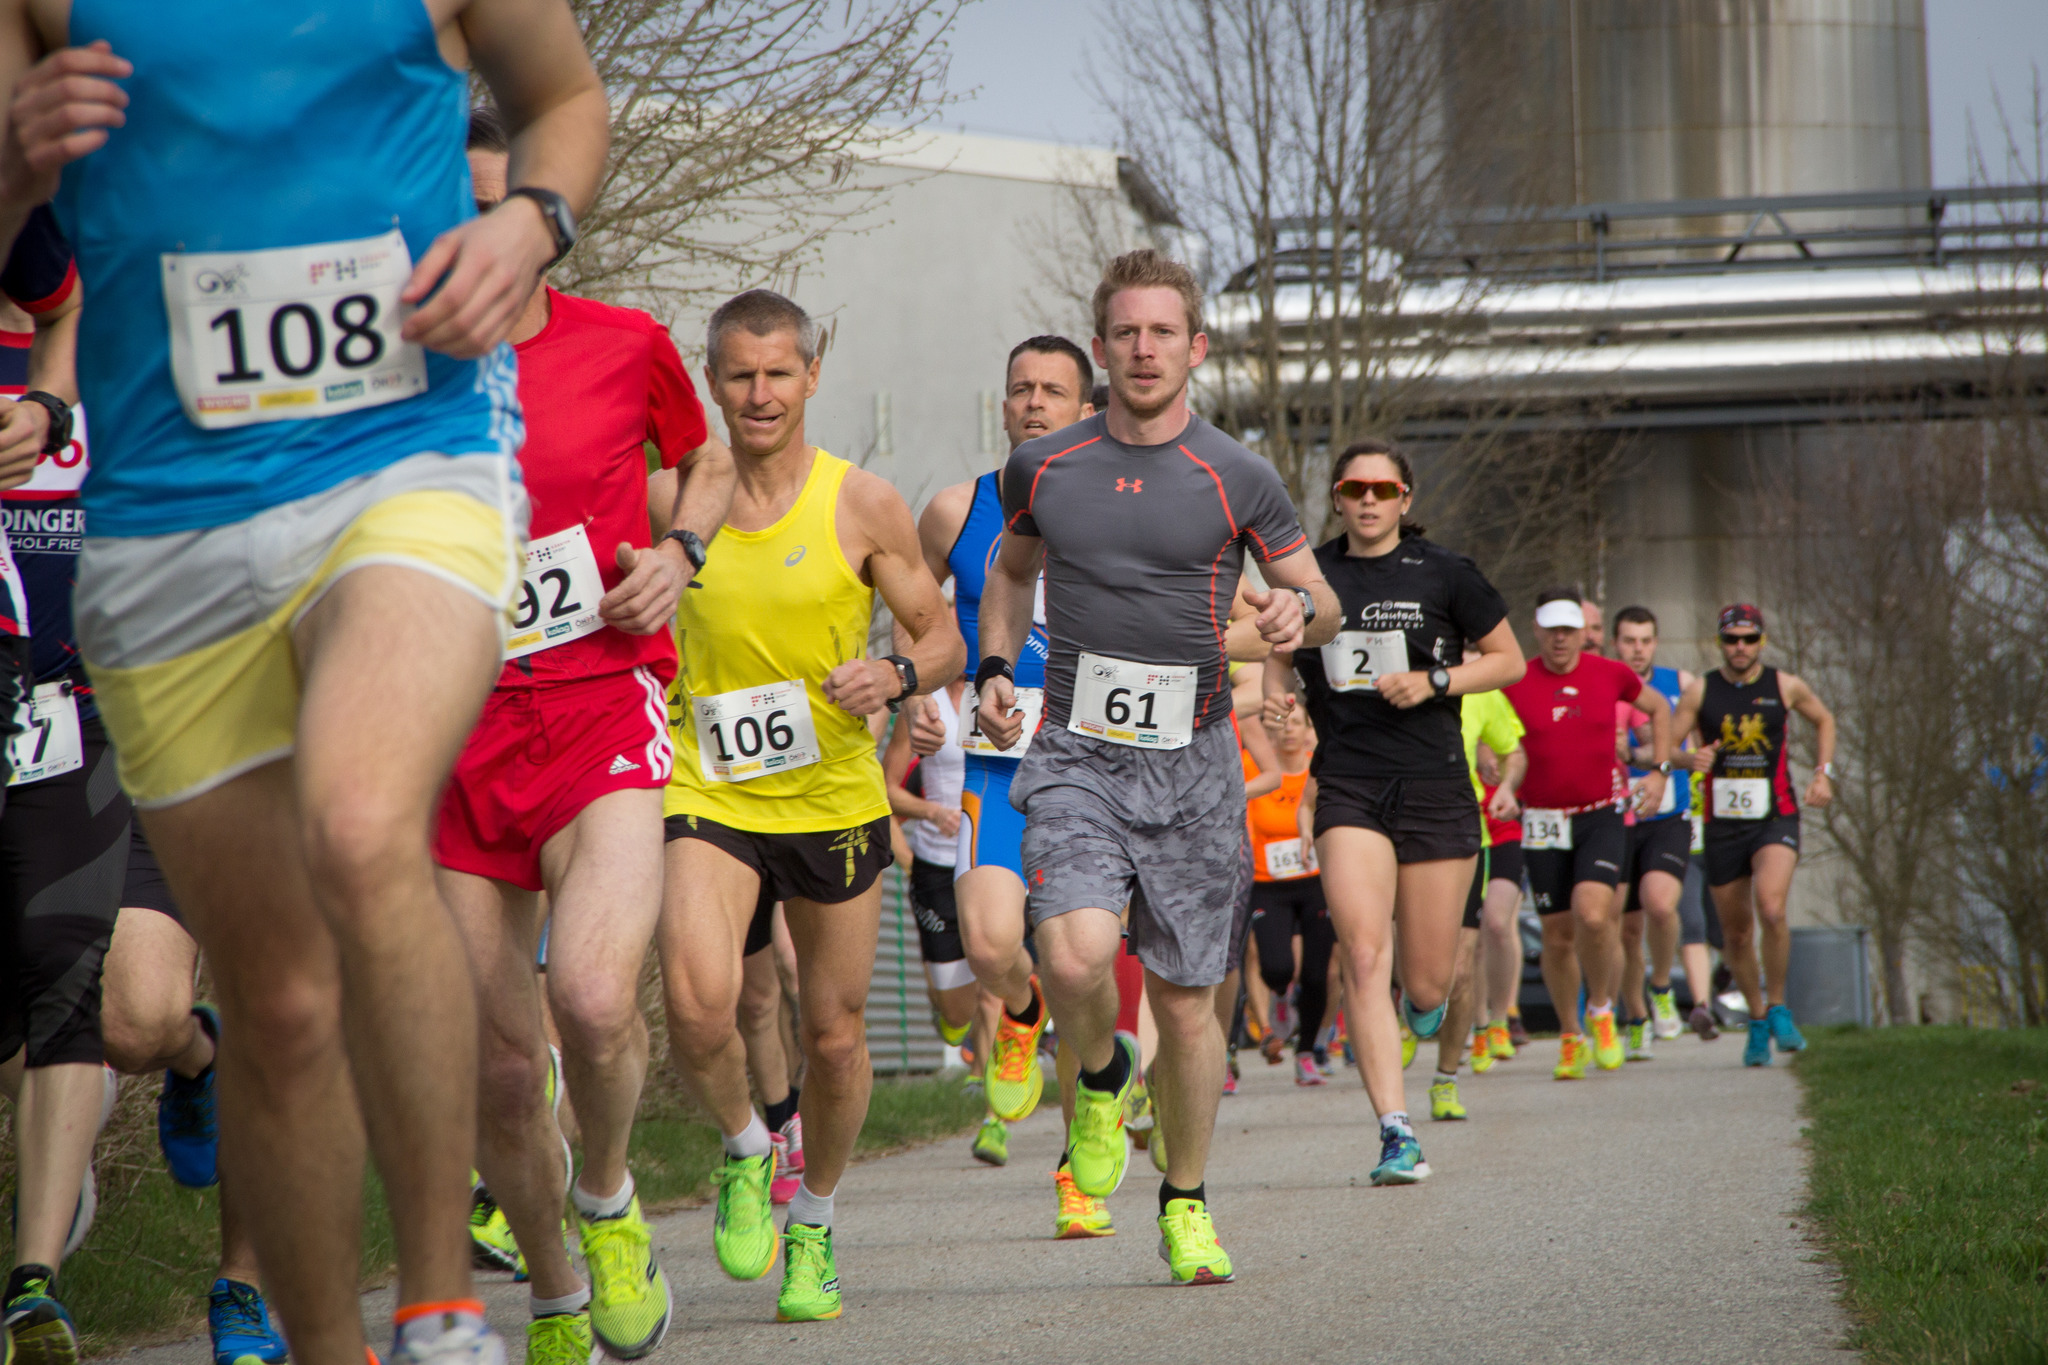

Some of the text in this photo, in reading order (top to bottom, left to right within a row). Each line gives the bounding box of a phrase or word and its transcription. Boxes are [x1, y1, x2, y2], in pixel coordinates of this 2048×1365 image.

[211, 293, 386, 384] 108
[0, 508, 86, 534] DINGER
[9, 536, 82, 550] HOLFRE
[513, 567, 582, 629] 92
[1361, 602, 1424, 622] Gautsch
[1352, 648, 1373, 675] 2
[1104, 687, 1158, 730] 61
[709, 709, 795, 762] 106
[1726, 790, 1753, 810] 26
[1526, 820, 1561, 840] 134
